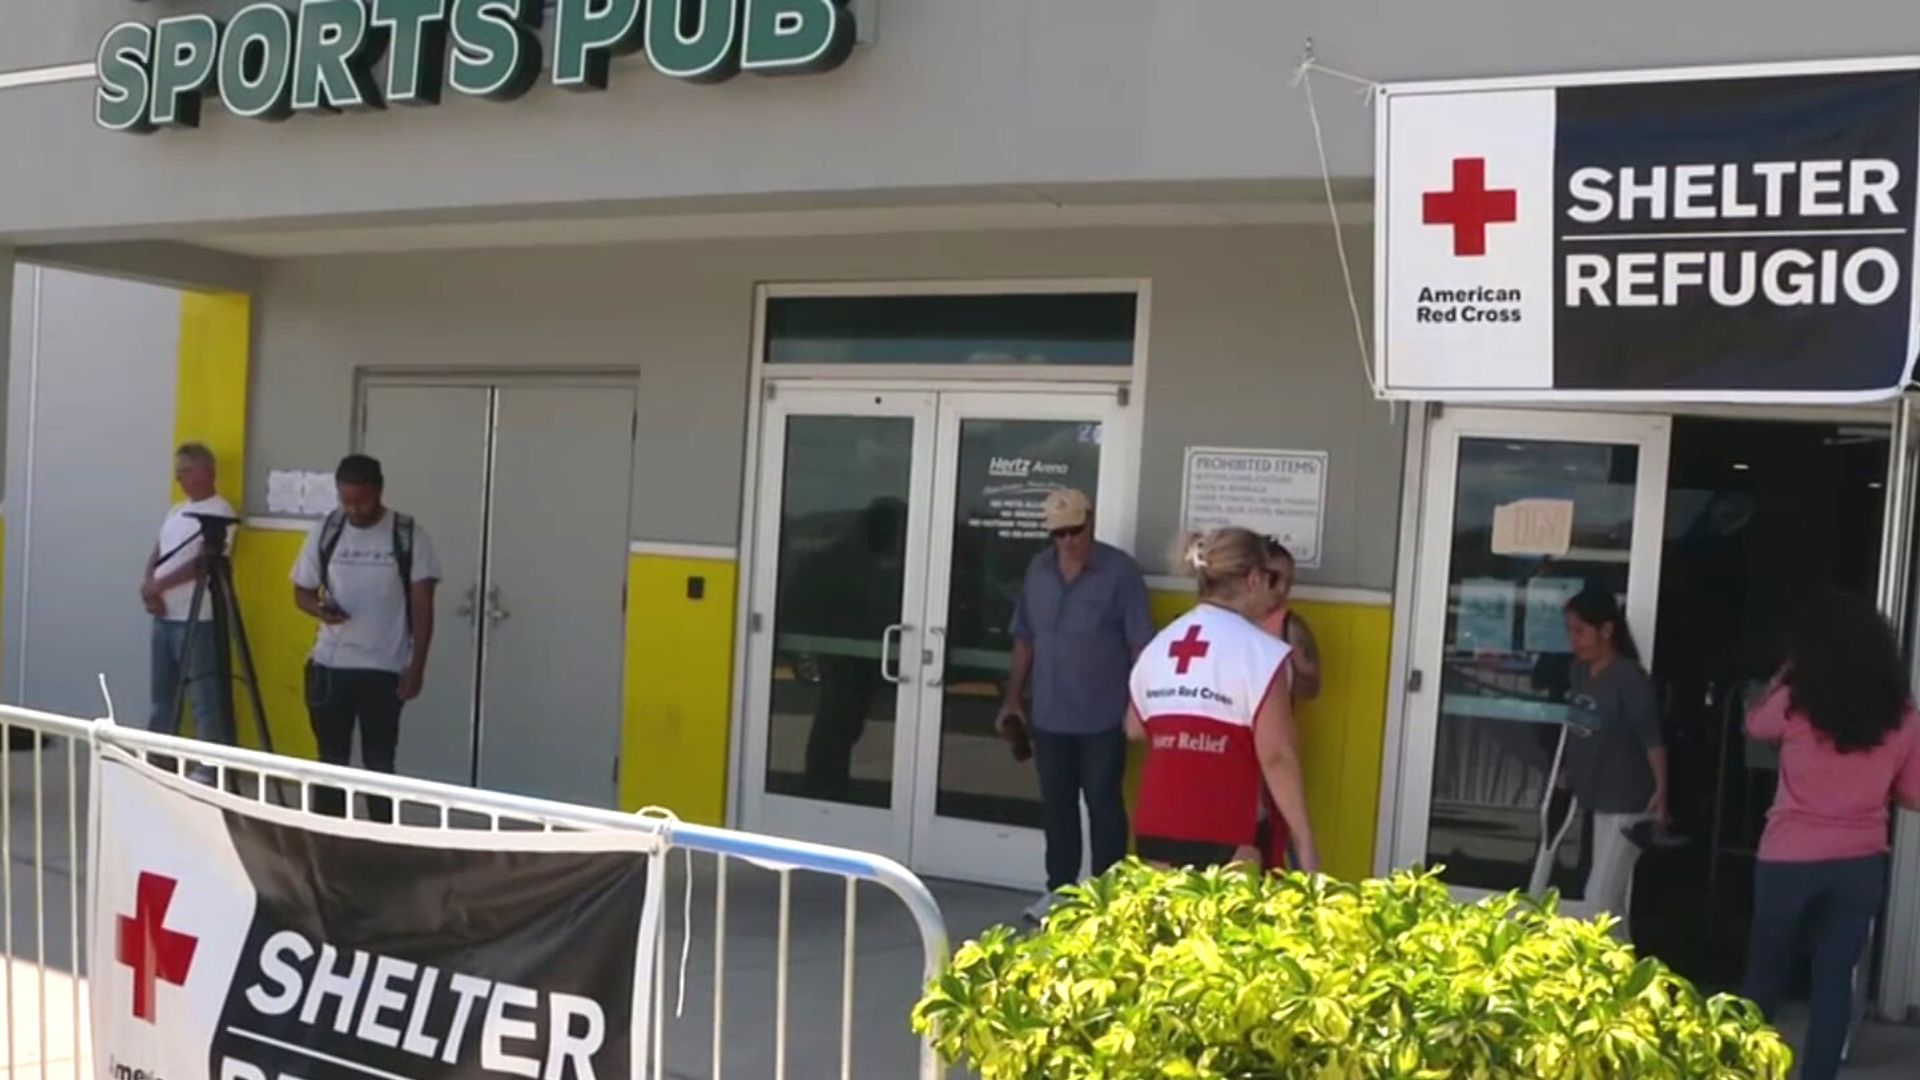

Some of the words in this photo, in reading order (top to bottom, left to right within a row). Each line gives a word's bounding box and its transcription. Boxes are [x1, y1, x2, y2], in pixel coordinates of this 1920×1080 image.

[95, 0, 521, 129] SPORTS
[553, 0, 838, 86] PUB
[1567, 158, 1899, 222] SHELTER
[1565, 247, 1899, 306] REFUGIO
[1417, 285, 1521, 303] American
[1417, 306, 1457, 323] Red
[1461, 306, 1521, 323] Cross
[989, 457, 1031, 474] Hertz
[1032, 461, 1068, 474] Arena
[1196, 457, 1272, 473] PROHIBITED
[1178, 685, 1198, 697] Red
[1200, 686, 1233, 705] Cross
[1178, 731, 1228, 754] Relief
[245, 930, 605, 1080] SHELTER
